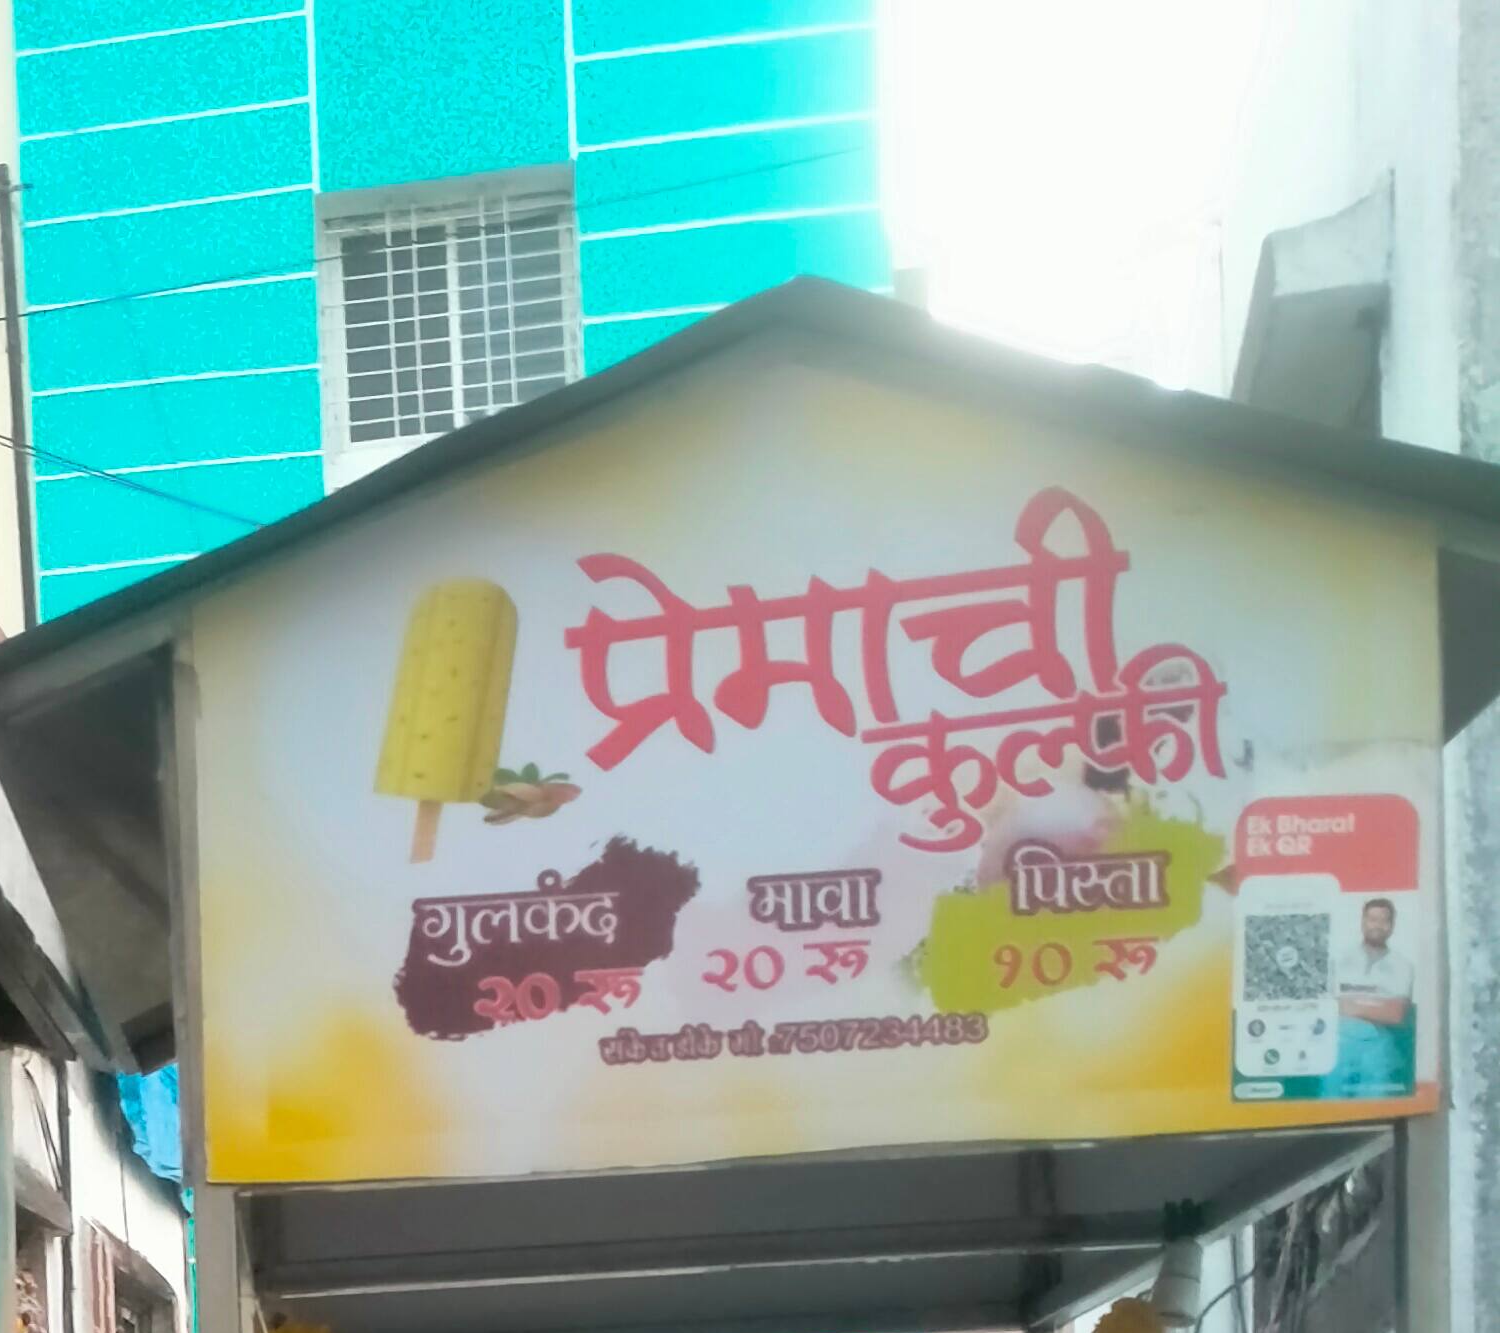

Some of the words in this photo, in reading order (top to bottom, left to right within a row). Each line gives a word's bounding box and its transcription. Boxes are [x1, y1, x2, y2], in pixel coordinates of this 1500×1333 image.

[566, 486, 1130, 771] प्रेमाची
[862, 644, 1226, 852] कुल्फी
[1247, 816, 1272, 835] Ek
[1276, 814, 1356, 834] Bharat
[1247, 838, 1272, 858] Ek
[1276, 836, 1313, 856] QR
[751, 873, 878, 928] मावा
[1010, 846, 1168, 912] पिस्ता
[421, 871, 620, 968] गुलकंद
[703, 946, 784, 992] २०
[803, 938, 869, 986] रू
[1095, 937, 1158, 981] रू
[575, 967, 644, 1014] रू
